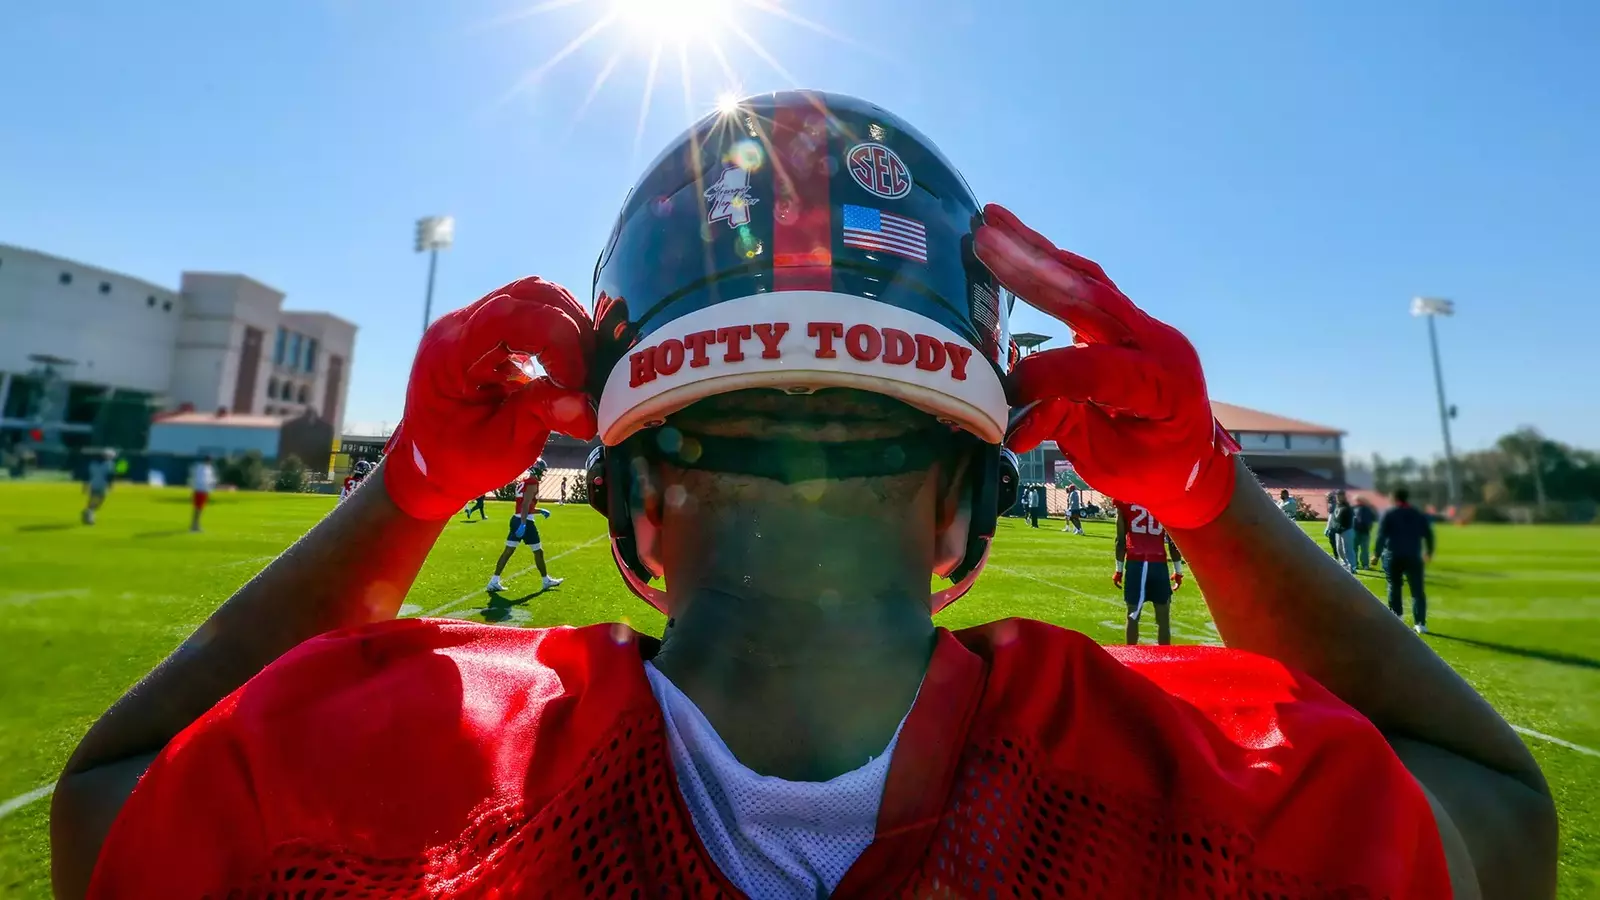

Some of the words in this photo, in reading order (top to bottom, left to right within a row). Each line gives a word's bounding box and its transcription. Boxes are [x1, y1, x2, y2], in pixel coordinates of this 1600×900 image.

[851, 145, 908, 195] SEC
[629, 323, 789, 388] HOTTY
[807, 322, 972, 380] TODDY
